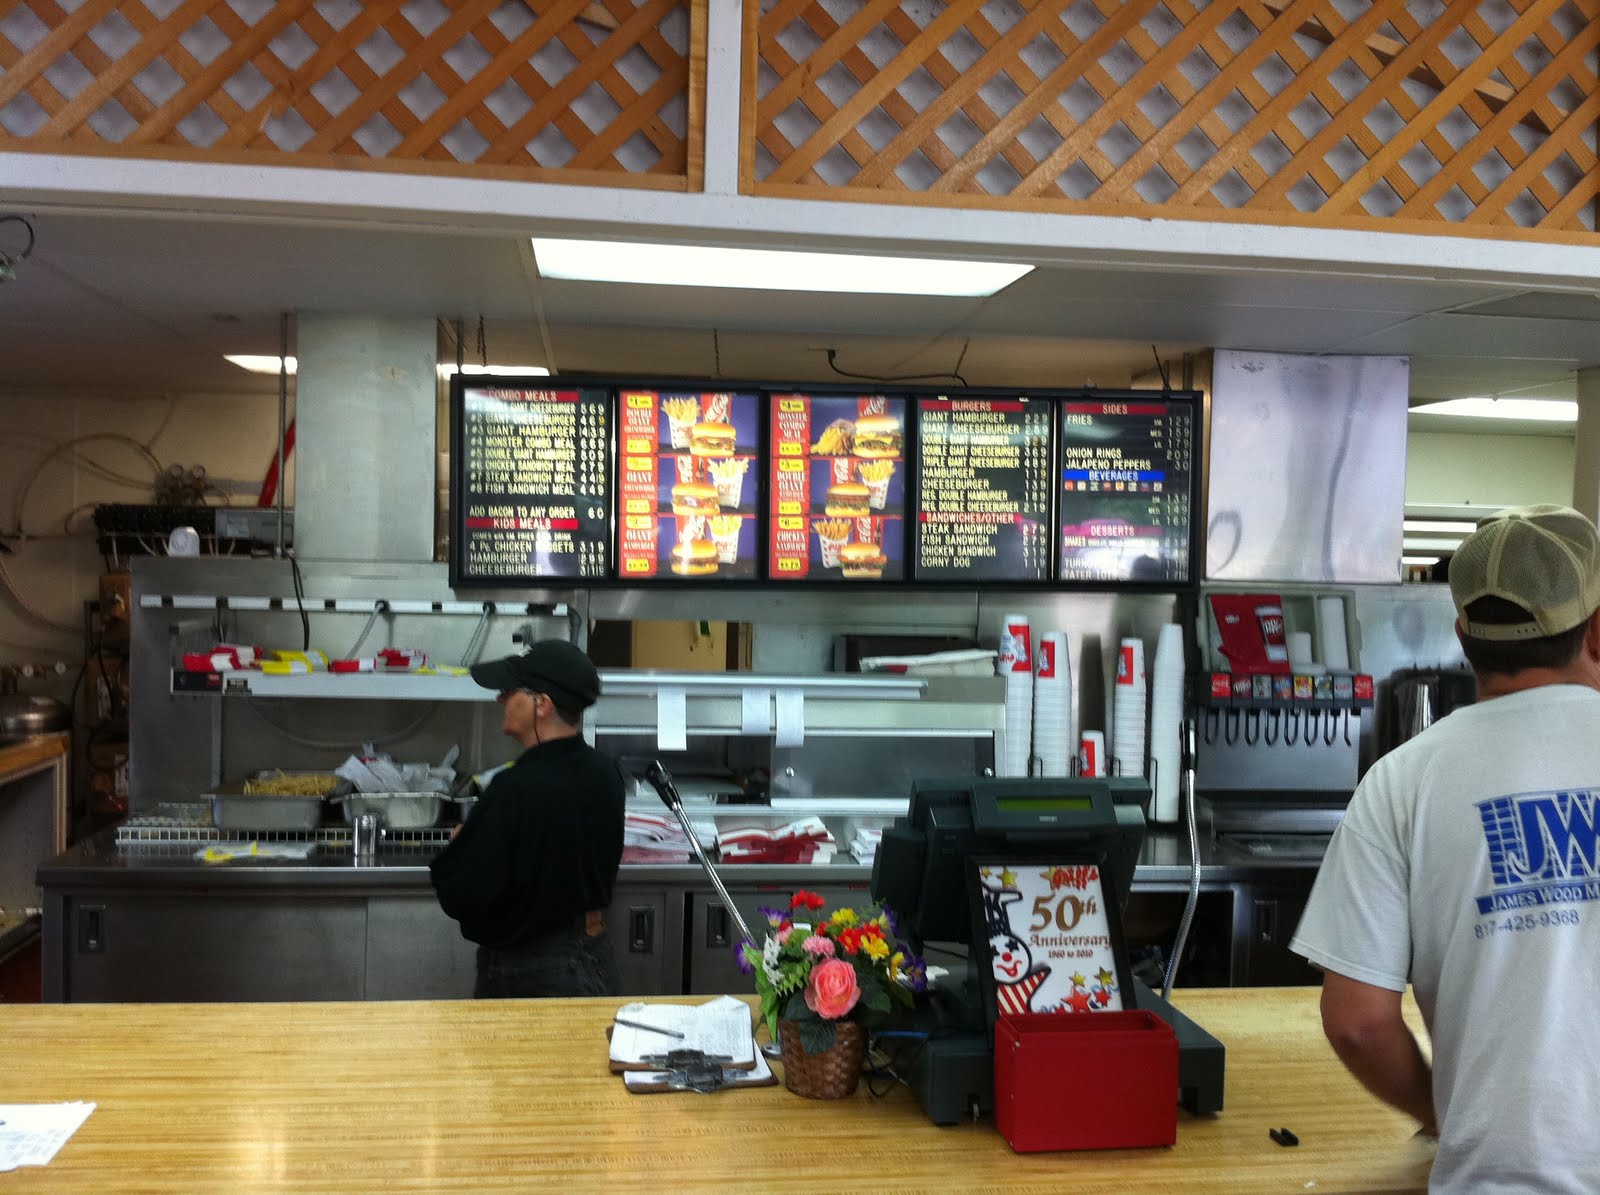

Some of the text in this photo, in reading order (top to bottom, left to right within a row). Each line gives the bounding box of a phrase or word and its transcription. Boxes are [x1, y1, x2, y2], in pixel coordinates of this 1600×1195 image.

[488, 390, 557, 401] COMBO MEALS
[952, 401, 992, 411] BURGERS
[1103, 405, 1128, 414] SIDES
[923, 412, 948, 422] GIANT
[953, 412, 1005, 423] HAMBURGER
[1067, 415, 1092, 425] FRIES
[487, 425, 514, 434] GIANT
[519, 426, 576, 437] HAMBURGER
[923, 423, 948, 433] GIANT
[952, 424, 1019, 434] CHEESEBURGER
[486, 436, 523, 447] MONSTER
[525, 437, 552, 448] COMBO
[554, 438, 576, 449] MEAL
[922, 434, 947, 444] DOUBLE
[950, 434, 968, 444] GIANT
[971, 435, 1009, 445] HAMBURGER
[486, 448, 511, 459] DOUBLE
[513, 449, 533, 459] GIANT
[536, 449, 576, 460] HAMBURGER
[922, 445, 947, 456] DOUBLE
[950, 445, 968, 456] GIANT
[971, 446, 1020, 457] CHEESEBURGER
[1066, 448, 1093, 459] ONION
[1097, 448, 1122, 459] RINGS
[486, 460, 515, 470] CHICKEN
[518, 460, 553, 471] SANDWICH
[556, 461, 576, 472] MEAL
[923, 456, 945, 466] TRIPLE
[948, 457, 967, 467] GIANT
[969, 457, 1020, 468] CHEESEBURGER
[1066, 459, 1109, 470] JALAPENO
[1113, 459, 1151, 470] PEPPERS
[486, 472, 510, 482] STEAK
[513, 472, 551, 483] SANDWICH
[554, 473, 576, 484] MEAL
[922, 468, 975, 478] HAMBURGER
[1089, 471, 1138, 481] BEVERAGES
[486, 483, 504, 494] FISH
[508, 484, 549, 495] SANDWICH
[553, 485, 575, 495] MEAL
[922, 479, 989, 489] CHEESEBURGER
[939, 490, 964, 500] DOUBLE
[968, 490, 1007, 501] HAMBURGER
[470, 506, 485, 516] ADD
[489, 506, 513, 517] BACON
[517, 506, 527, 518] TO
[530, 507, 546, 518] ANY
[550, 507, 575, 518] ORDER
[939, 501, 964, 512] DOUBLE
[968, 502, 1018, 512] CHEESEBURGER
[926, 512, 1014, 523] SANDWICHES/OTHER
[494, 518, 551, 530] KIDS MEALS
[922, 524, 949, 534] STEAK
[954, 524, 997, 534] SANDWICH
[1091, 525, 1134, 536] DESSERTS
[777, 532, 805, 541] CHICKEN
[922, 535, 941, 545] FISH
[946, 535, 989, 545] SANDWICH
[1065, 536, 1086, 547] SHAKES
[495, 541, 532, 552] CHICKEN
[922, 546, 953, 556] CHICKEN
[958, 546, 996, 557] SANDWICH
[471, 553, 527, 563] HAMBURGER
[922, 557, 949, 568] CORNY
[954, 558, 971, 567] DOG
[470, 564, 542, 575] CHEESEBURGER
[1065, 569, 1091, 579] TATER
[1491, 891, 1537, 911] JAMES
[1539, 887, 1583, 904] WOOD
[1030, 895, 1097, 932] 50th
[1029, 934, 1110, 950] Anniversary
